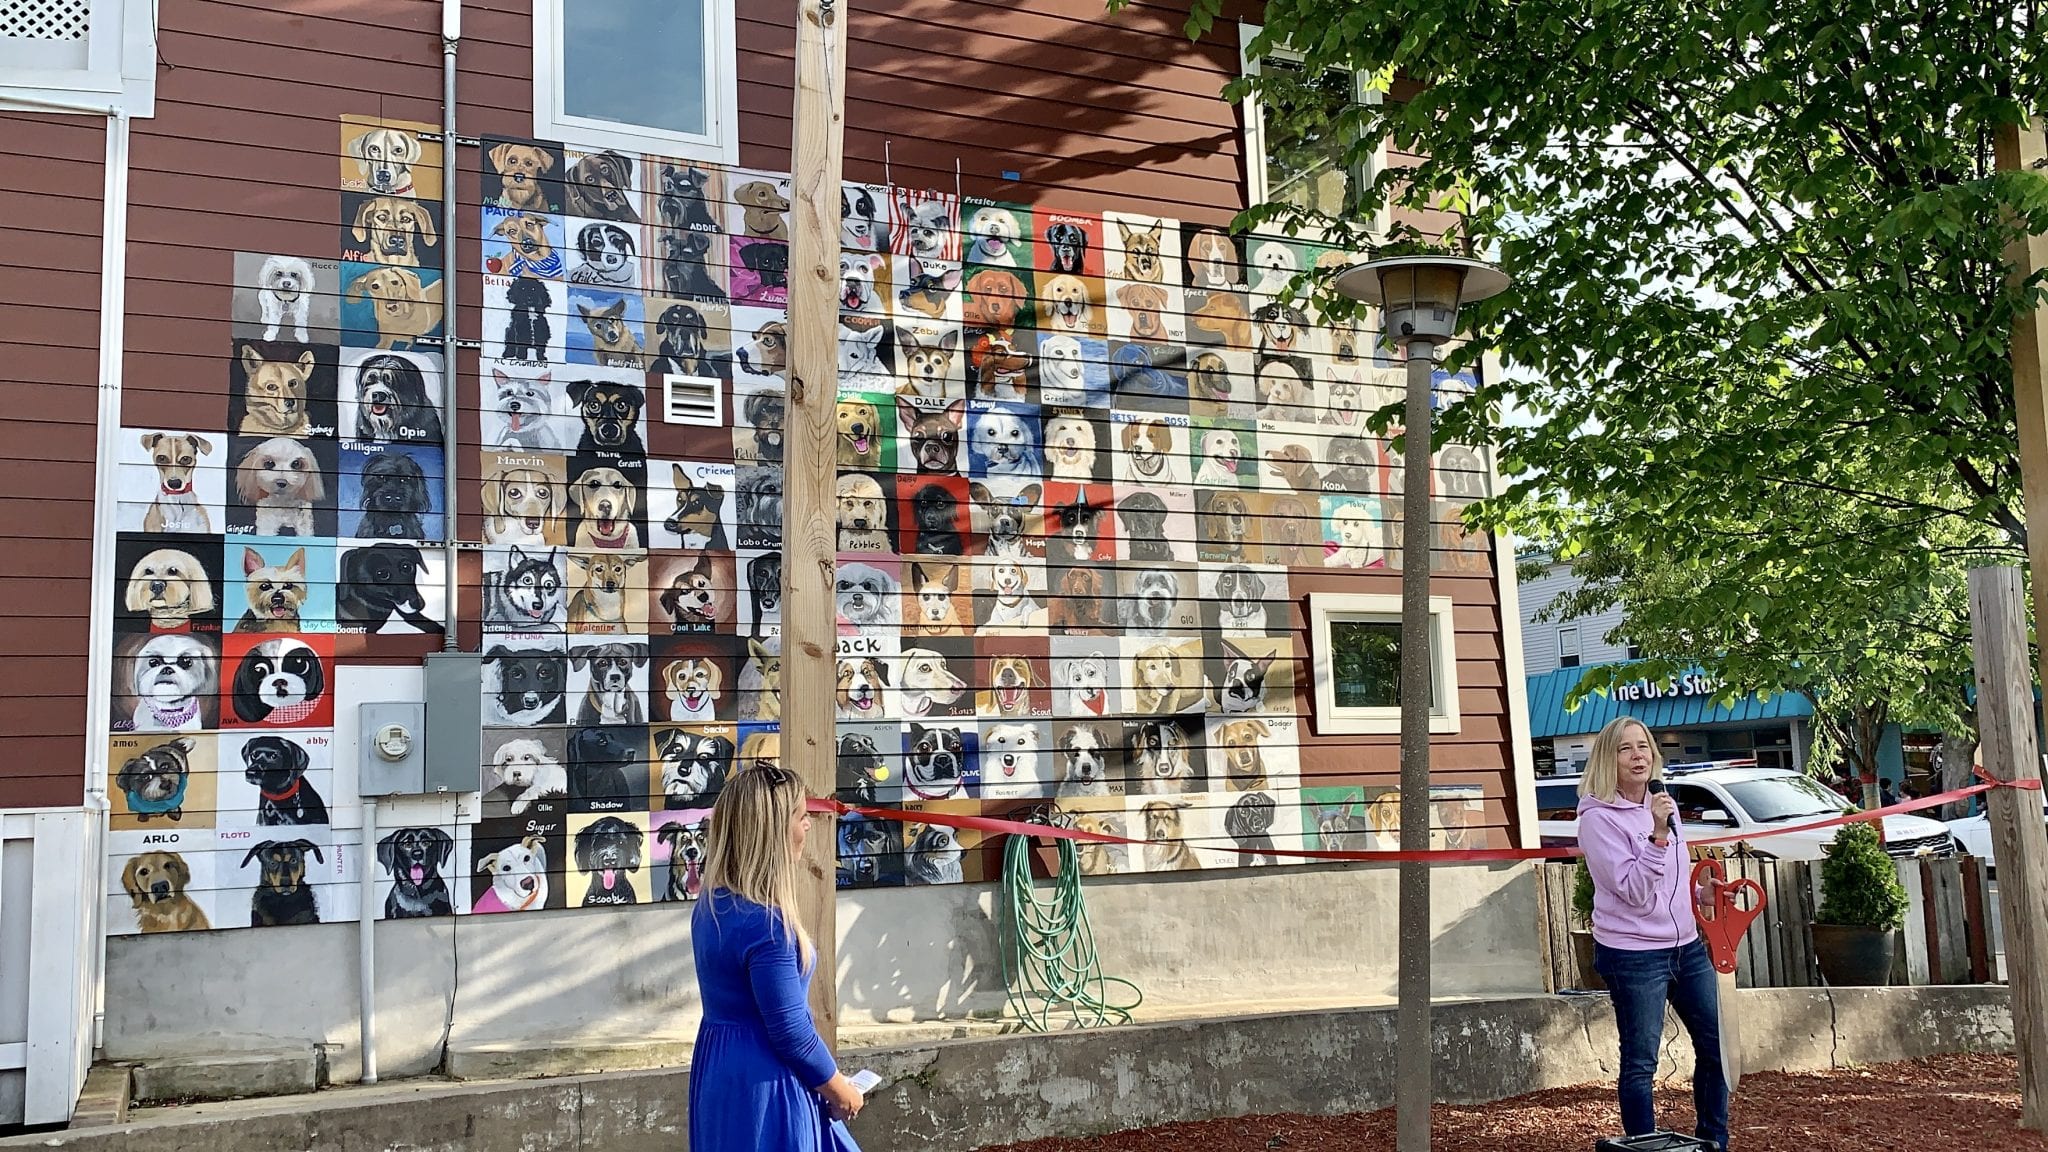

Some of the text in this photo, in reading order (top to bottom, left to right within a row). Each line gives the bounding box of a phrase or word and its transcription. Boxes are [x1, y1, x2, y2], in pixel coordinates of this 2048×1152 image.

[964, 196, 996, 207] Presley
[486, 206, 524, 218] PAIGE
[690, 222, 718, 233] ADDIE
[922, 261, 947, 271] Duke
[912, 326, 939, 336] Zebu
[914, 397, 946, 408] DALE
[1164, 416, 1188, 427] ROSS
[1261, 422, 1276, 431] Mac
[400, 426, 427, 438] Opie
[341, 442, 384, 456] Gilligan
[496, 456, 545, 467] Marvin
[617, 458, 643, 468] Grant
[696, 466, 736, 479] Cricket
[226, 524, 254, 534] Ginger
[738, 538, 760, 546] Lobo
[850, 540, 881, 550] Pebbles
[1031, 708, 1052, 716] Scout
[1268, 719, 1292, 731] Dodger
[112, 740, 138, 748] amos
[306, 736, 329, 746] abby
[1108, 785, 1124, 793] MAX
[590, 801, 624, 810] Shadow
[526, 820, 557, 836] Sugar
[142, 833, 180, 845] ARLO
[220, 832, 251, 840] FLOYD
